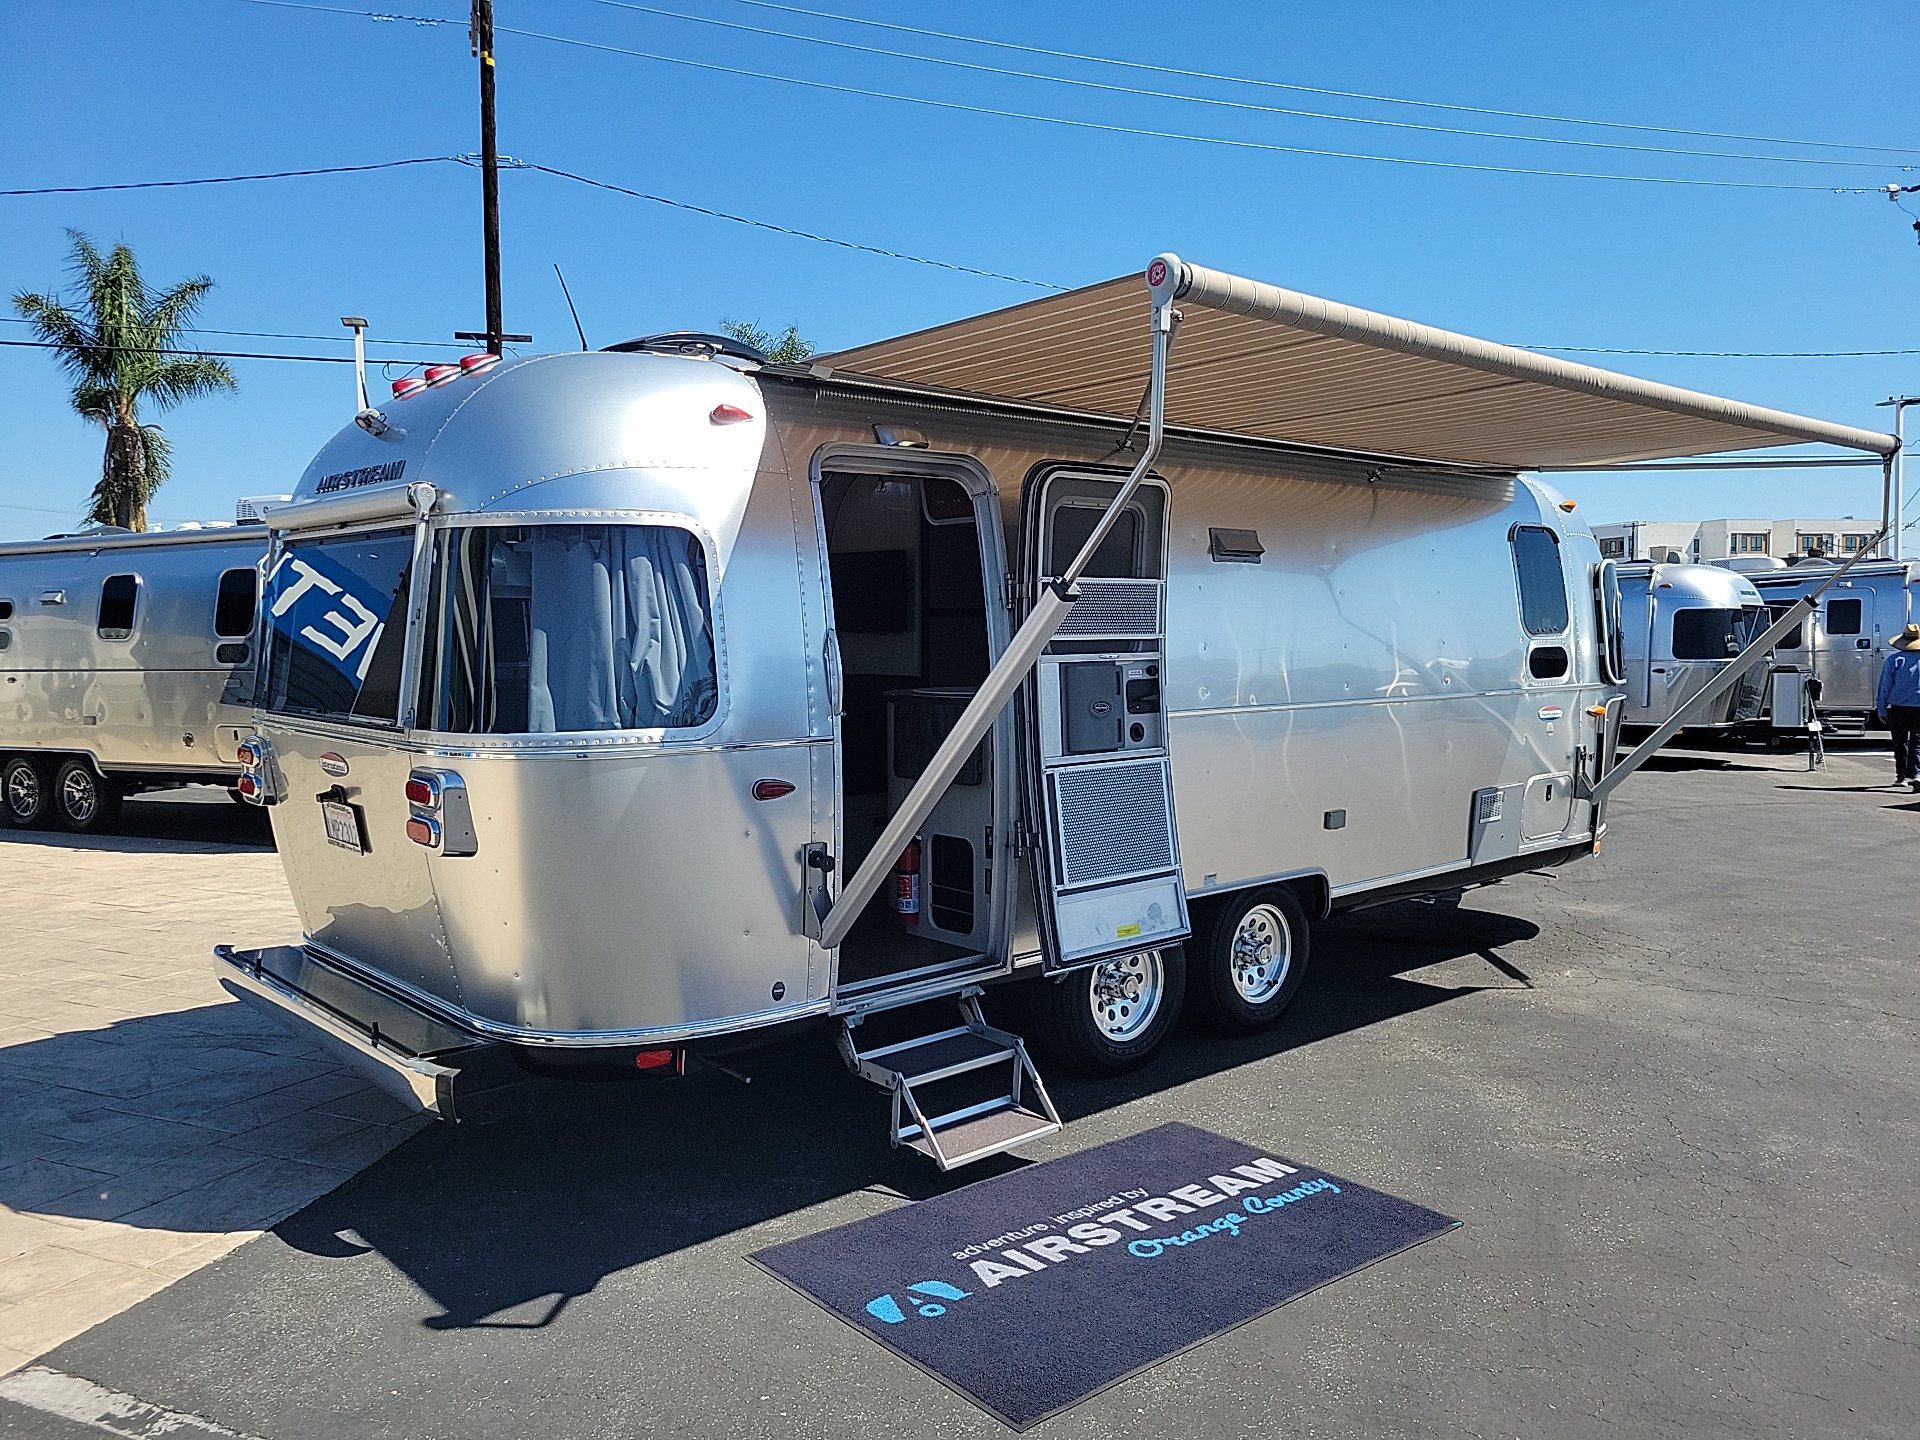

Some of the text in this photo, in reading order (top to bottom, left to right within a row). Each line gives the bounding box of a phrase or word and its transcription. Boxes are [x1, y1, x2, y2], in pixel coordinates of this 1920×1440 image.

[315, 460, 407, 494] AIRSTREAM
[952, 1187, 1150, 1260] adventure, inspired by
[969, 1157, 1299, 1288] AIRSTREAM
[1128, 1178, 1341, 1258] Orange County
